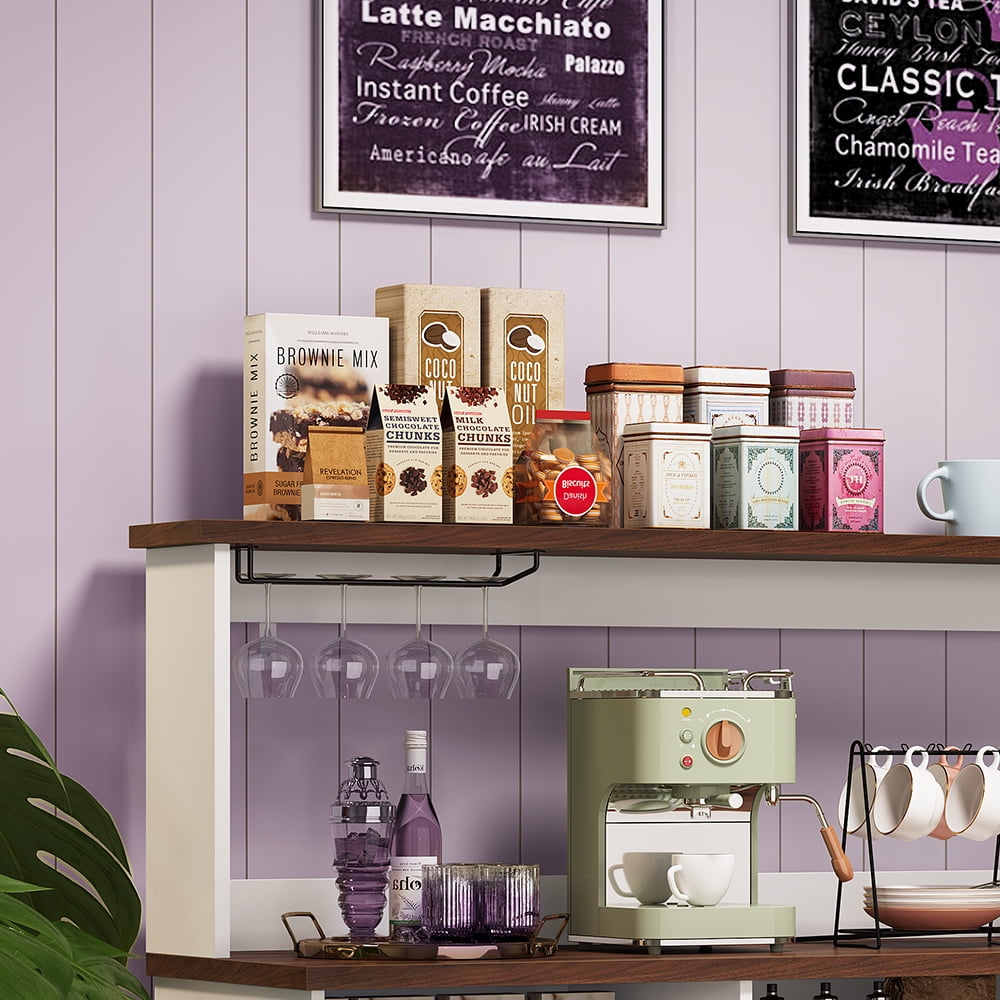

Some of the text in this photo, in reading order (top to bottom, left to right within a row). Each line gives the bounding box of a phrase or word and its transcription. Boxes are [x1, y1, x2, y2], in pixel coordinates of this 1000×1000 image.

[361, 0, 611, 39] Latte Macchiato
[839, 10, 982, 45] CEYLON
[401, 29, 538, 51] FRENCH ROAST
[832, 38, 898, 65] Honey
[910, 43, 964, 62] Bush
[356, 41, 547, 83] Raspberry Mocha
[565, 53, 625, 76] Palazzo
[357, 75, 529, 108] Instant Coffee
[837, 63, 975, 98] CLASSIC
[352, 101, 524, 150] Frozen Coffee
[523, 113, 622, 136] IRISH CREAM
[833, 97, 911, 140] Angel
[907, 101, 981, 133] Peach
[369, 143, 472, 166] Americano
[522, 153, 550, 168] au
[552, 142, 629, 171] Lait
[835, 133, 1000, 164] Chamomile Tea
[834, 163, 906, 190] Irish
[277, 346, 379, 369] BROWNIE MIX
[425, 358, 456, 379] COCO
[510, 361, 541, 382] COCO
[429, 380, 453, 400] NU
[514, 384, 538, 403] NUT
[250, 353, 259, 462] BROWNIE MIX
[383, 415, 438, 423] SEMISWEET
[511, 404, 536, 425] OIL
[456, 416, 484, 424] MILK
[457, 425, 511, 433] CHOCOLATE
[386, 431, 440, 441] CHUNKS
[457, 433, 511, 443] CHUNKS
[320, 468, 362, 476] REVELATION
